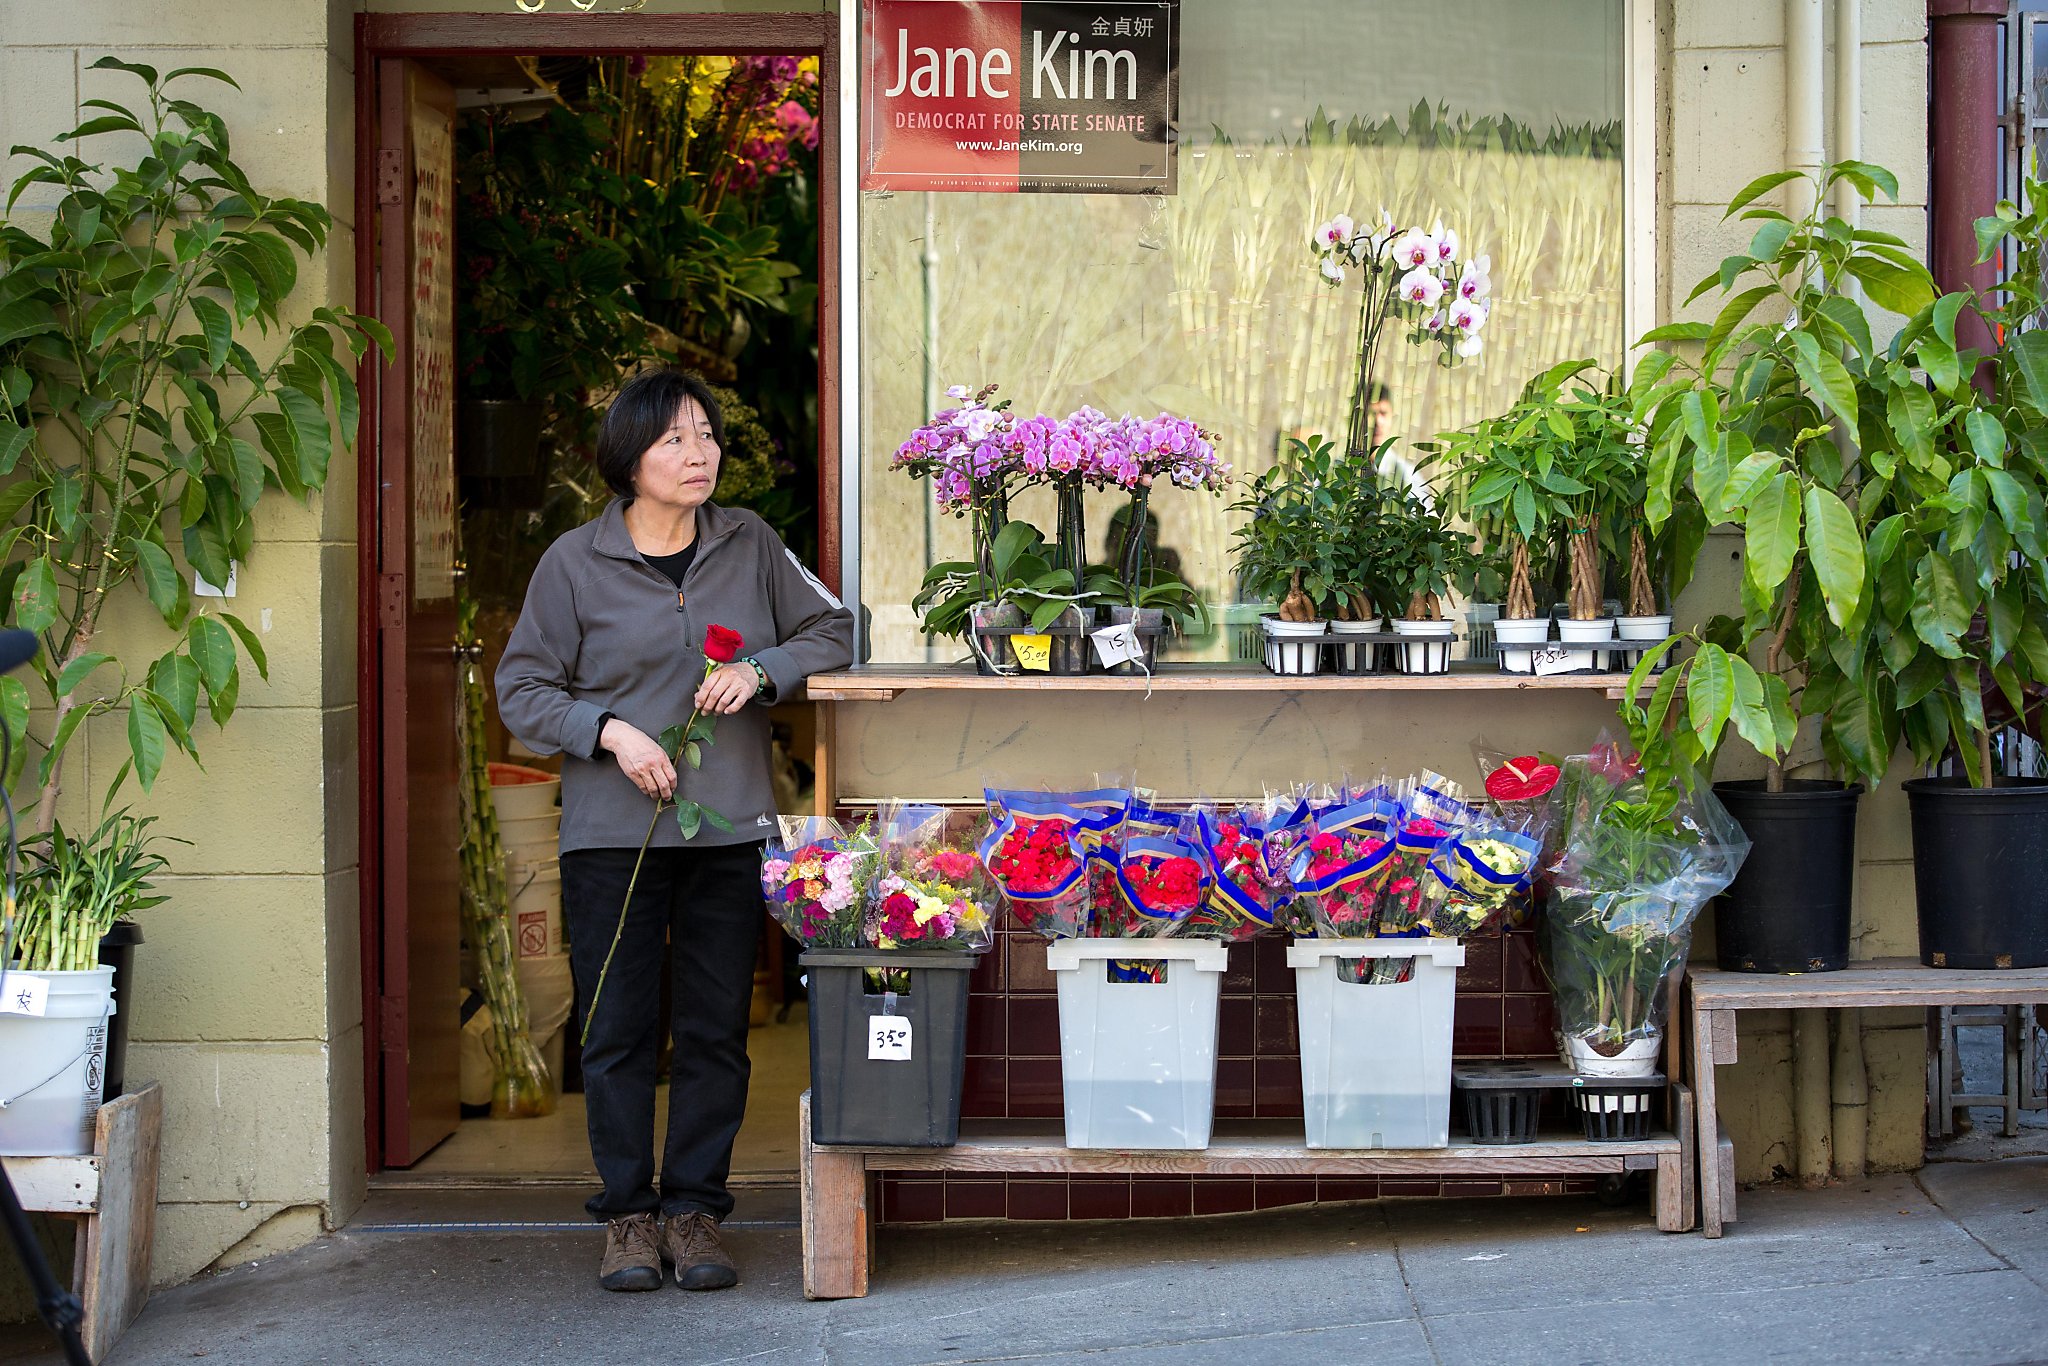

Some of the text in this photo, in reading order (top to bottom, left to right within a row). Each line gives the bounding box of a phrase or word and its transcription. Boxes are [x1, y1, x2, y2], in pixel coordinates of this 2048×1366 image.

[1091, 16, 1154, 37] 金貞妍
[885, 28, 1137, 100] Jane Kim
[895, 112, 1145, 132] DEMOCRAT FOR STATE SENATE
[956, 139, 1083, 154] www.JaneKim.org
